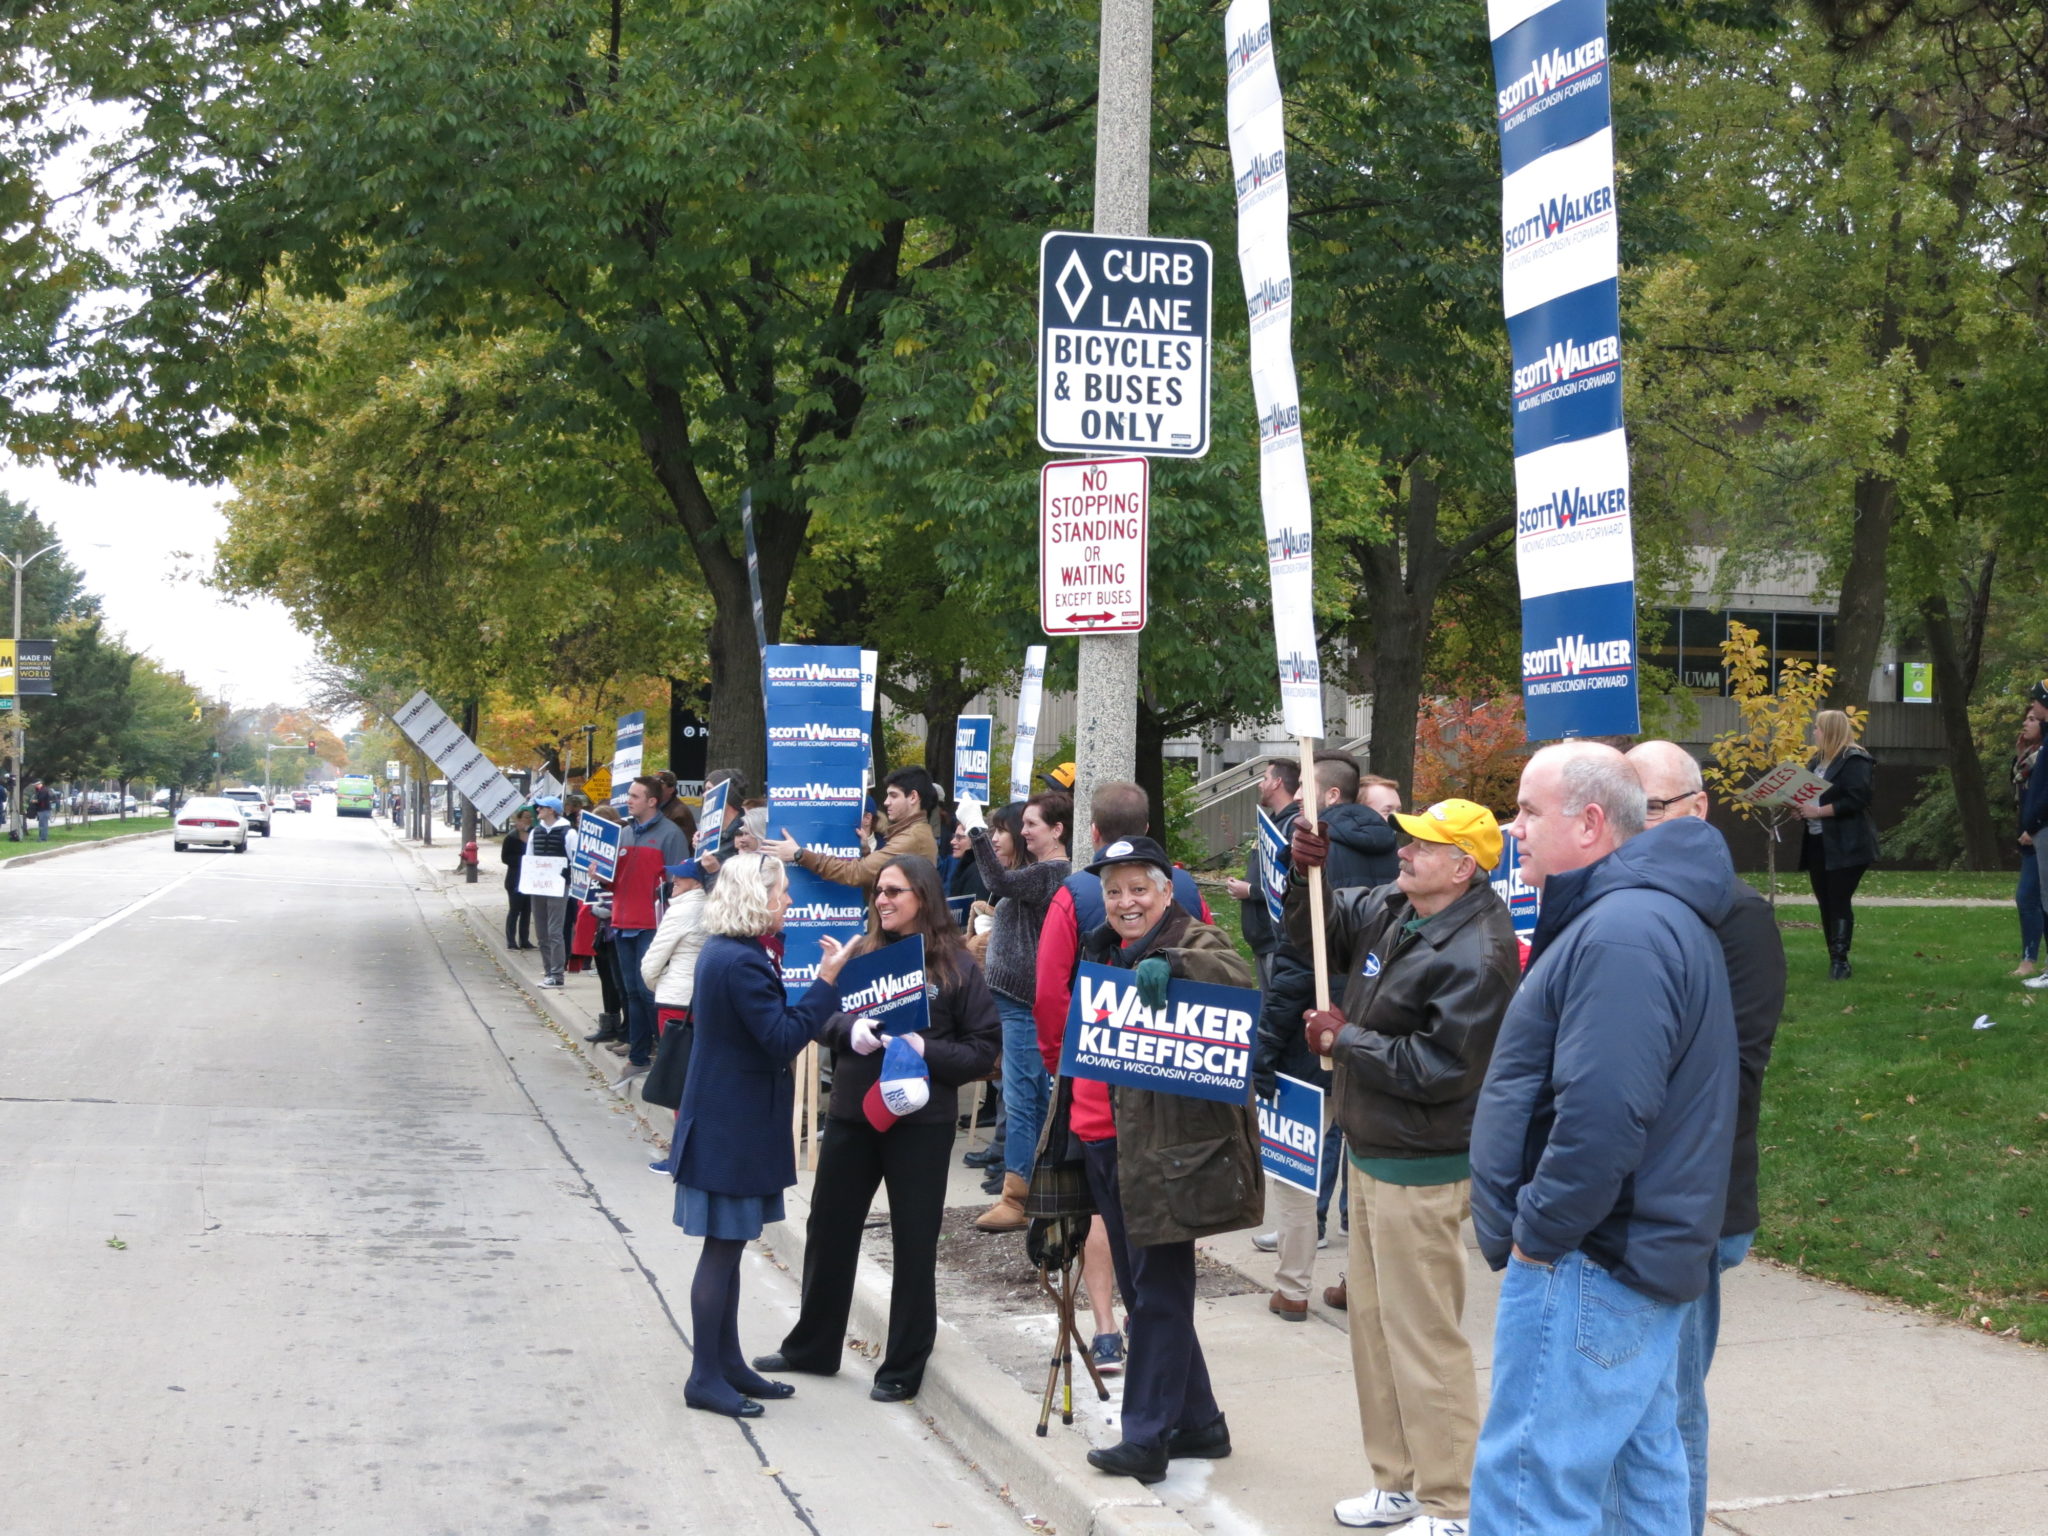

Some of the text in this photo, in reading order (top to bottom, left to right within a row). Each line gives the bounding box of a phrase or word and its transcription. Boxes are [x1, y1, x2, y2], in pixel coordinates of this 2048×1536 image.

[1499, 37, 1606, 114] SCOTT WALKER
[1251, 149, 1284, 190] WALKER
[1505, 186, 1612, 253] SCOTT WALKER
[1103, 248, 1195, 286] CURB
[1102, 295, 1192, 331] LANE
[1055, 335, 1192, 371] BICYCLES
[1514, 335, 1619, 393] SCOTT WALKER
[1054, 371, 1183, 406] & BUSES
[1081, 409, 1164, 442] ONLY
[1082, 470, 1107, 491] NO
[1051, 492, 1139, 518] STOPPING
[1519, 486, 1626, 534] SCOTT WALKER
[1052, 518, 1138, 544] STANDING
[1084, 546, 1100, 562] OR
[1061, 563, 1125, 587] WAITING
[1055, 590, 1132, 607] EXCEPT BUSES
[768, 667, 805, 679] SCOTT
[803, 663, 860, 680] WALKER
[1523, 634, 1631, 677] SCOTT WALKER
[1685, 671, 1720, 687] UWM
[769, 727, 806, 738] SCOTT
[805, 723, 861, 740] WALKER
[770, 783, 861, 800] SCOTT WALKER
[582, 820, 603, 838] SCOTT
[580, 833, 616, 860] WALKER
[807, 903, 862, 920] WALKER
[1511, 906, 1536, 917] FORWARD
[841, 988, 874, 1013] SCOTT
[871, 970, 923, 1004] WALKER
[1080, 976, 1253, 1044] WALKER
[1078, 1025, 1249, 1077] KLEEFISCH
[1075, 1053, 1245, 1090] MOVING WISCONSIN FORWARD
[1257, 1106, 1316, 1156] ALKER
[1260, 1146, 1285, 1165] SCONSIN
[1285, 1155, 1315, 1176] FORWARD
